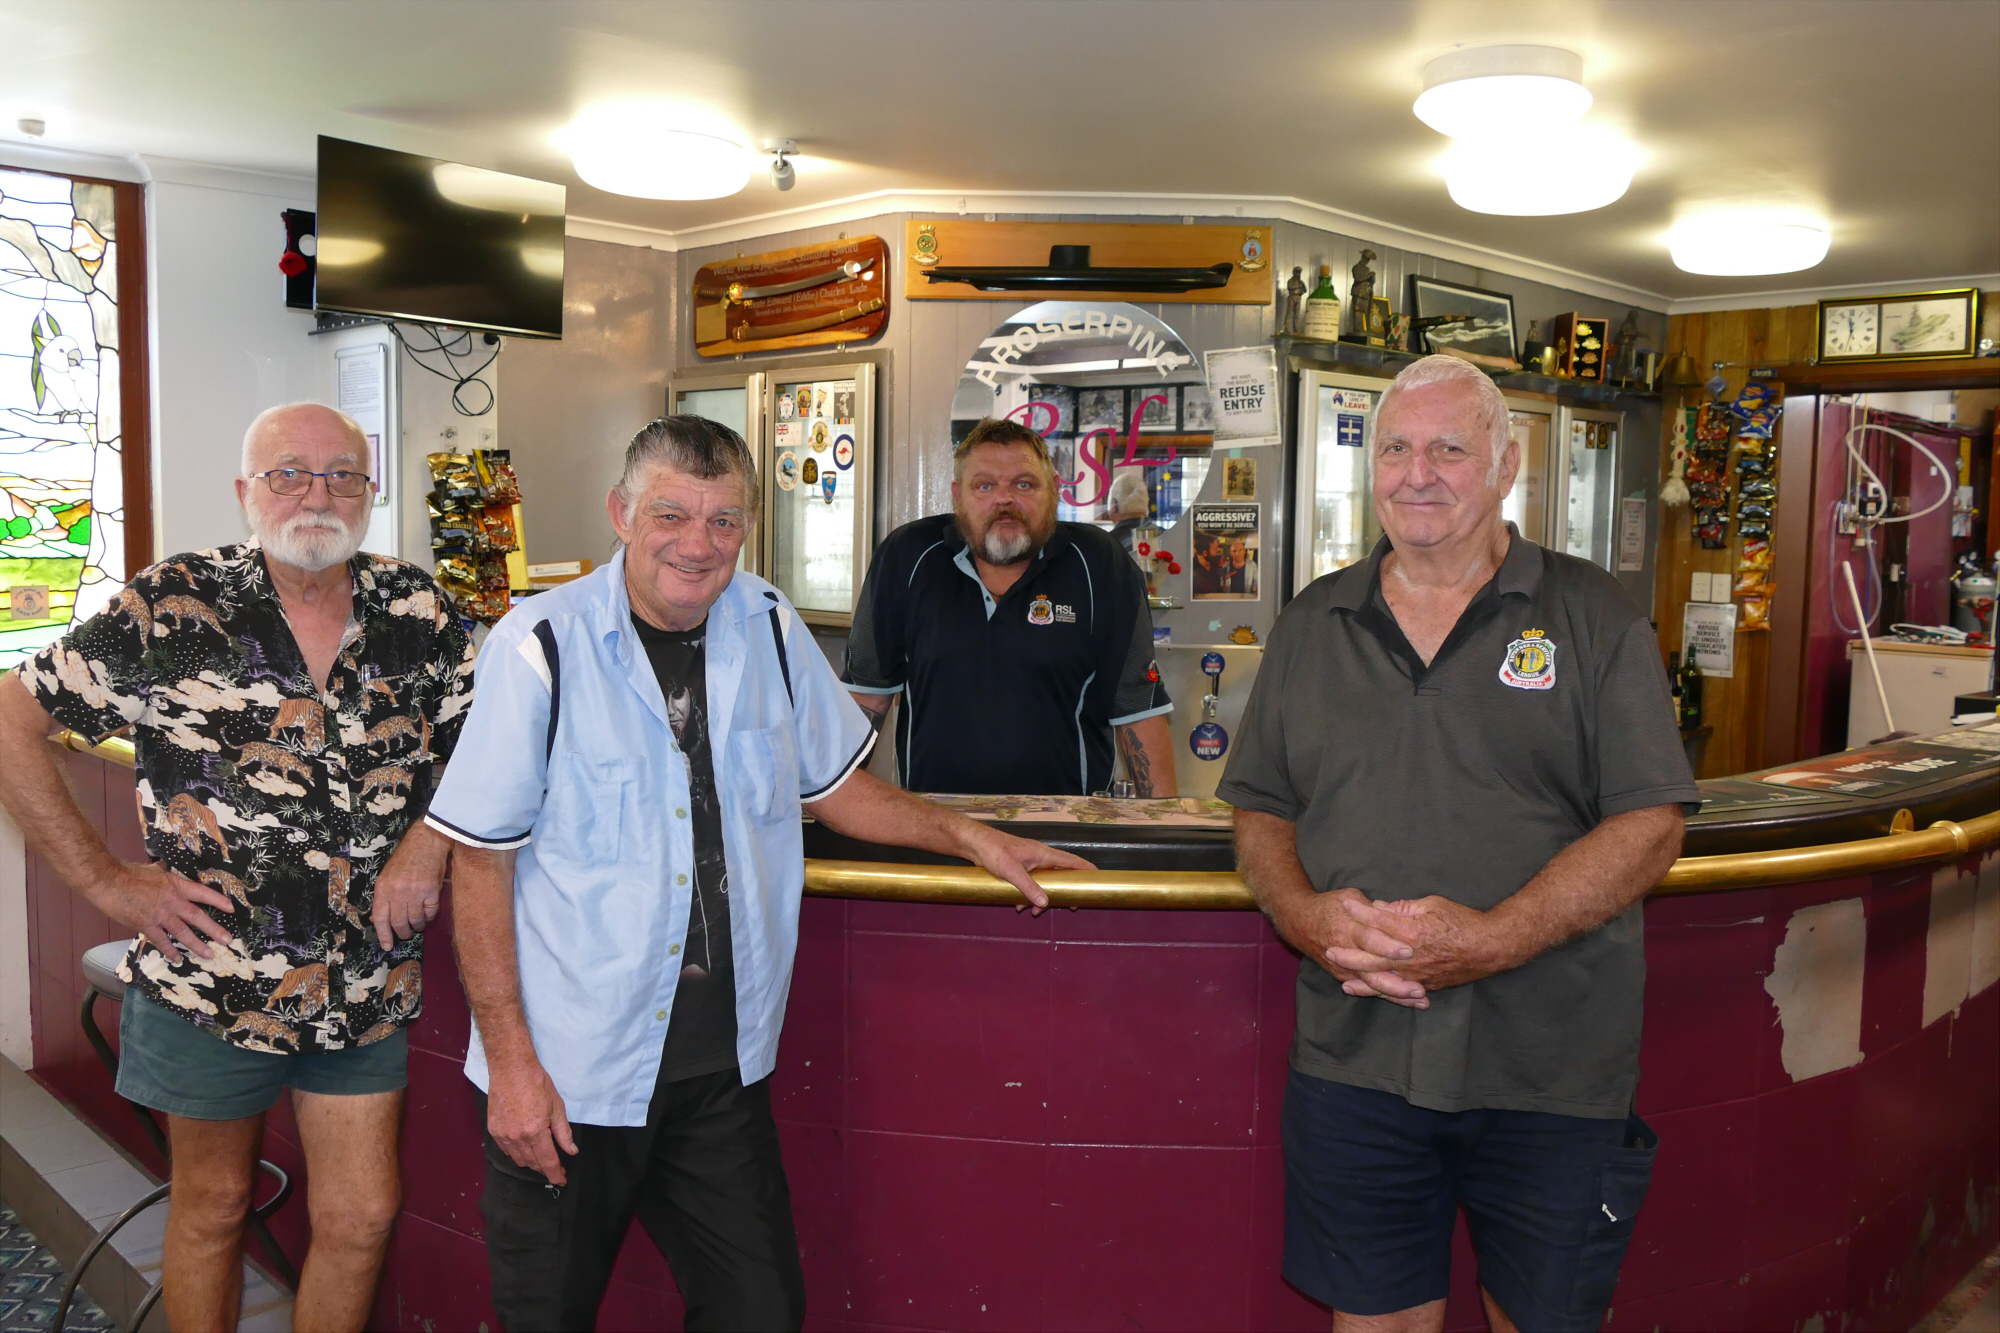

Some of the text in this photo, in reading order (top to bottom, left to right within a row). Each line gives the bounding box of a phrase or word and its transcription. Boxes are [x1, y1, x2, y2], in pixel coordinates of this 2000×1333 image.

[832, 243, 858, 256] Sword
[767, 295, 792, 306] Edward
[820, 286, 846, 298] Charles
[850, 282, 868, 294] Lade
[975, 310, 1178, 390] PROSERPINE
[1220, 384, 1266, 398] REFUSE
[1224, 397, 1263, 410] ENTRY
[1196, 512, 1256, 522] AGGRESSIVE?
[1055, 605, 1076, 614] RSL
[1197, 747, 1220, 755] NEW
